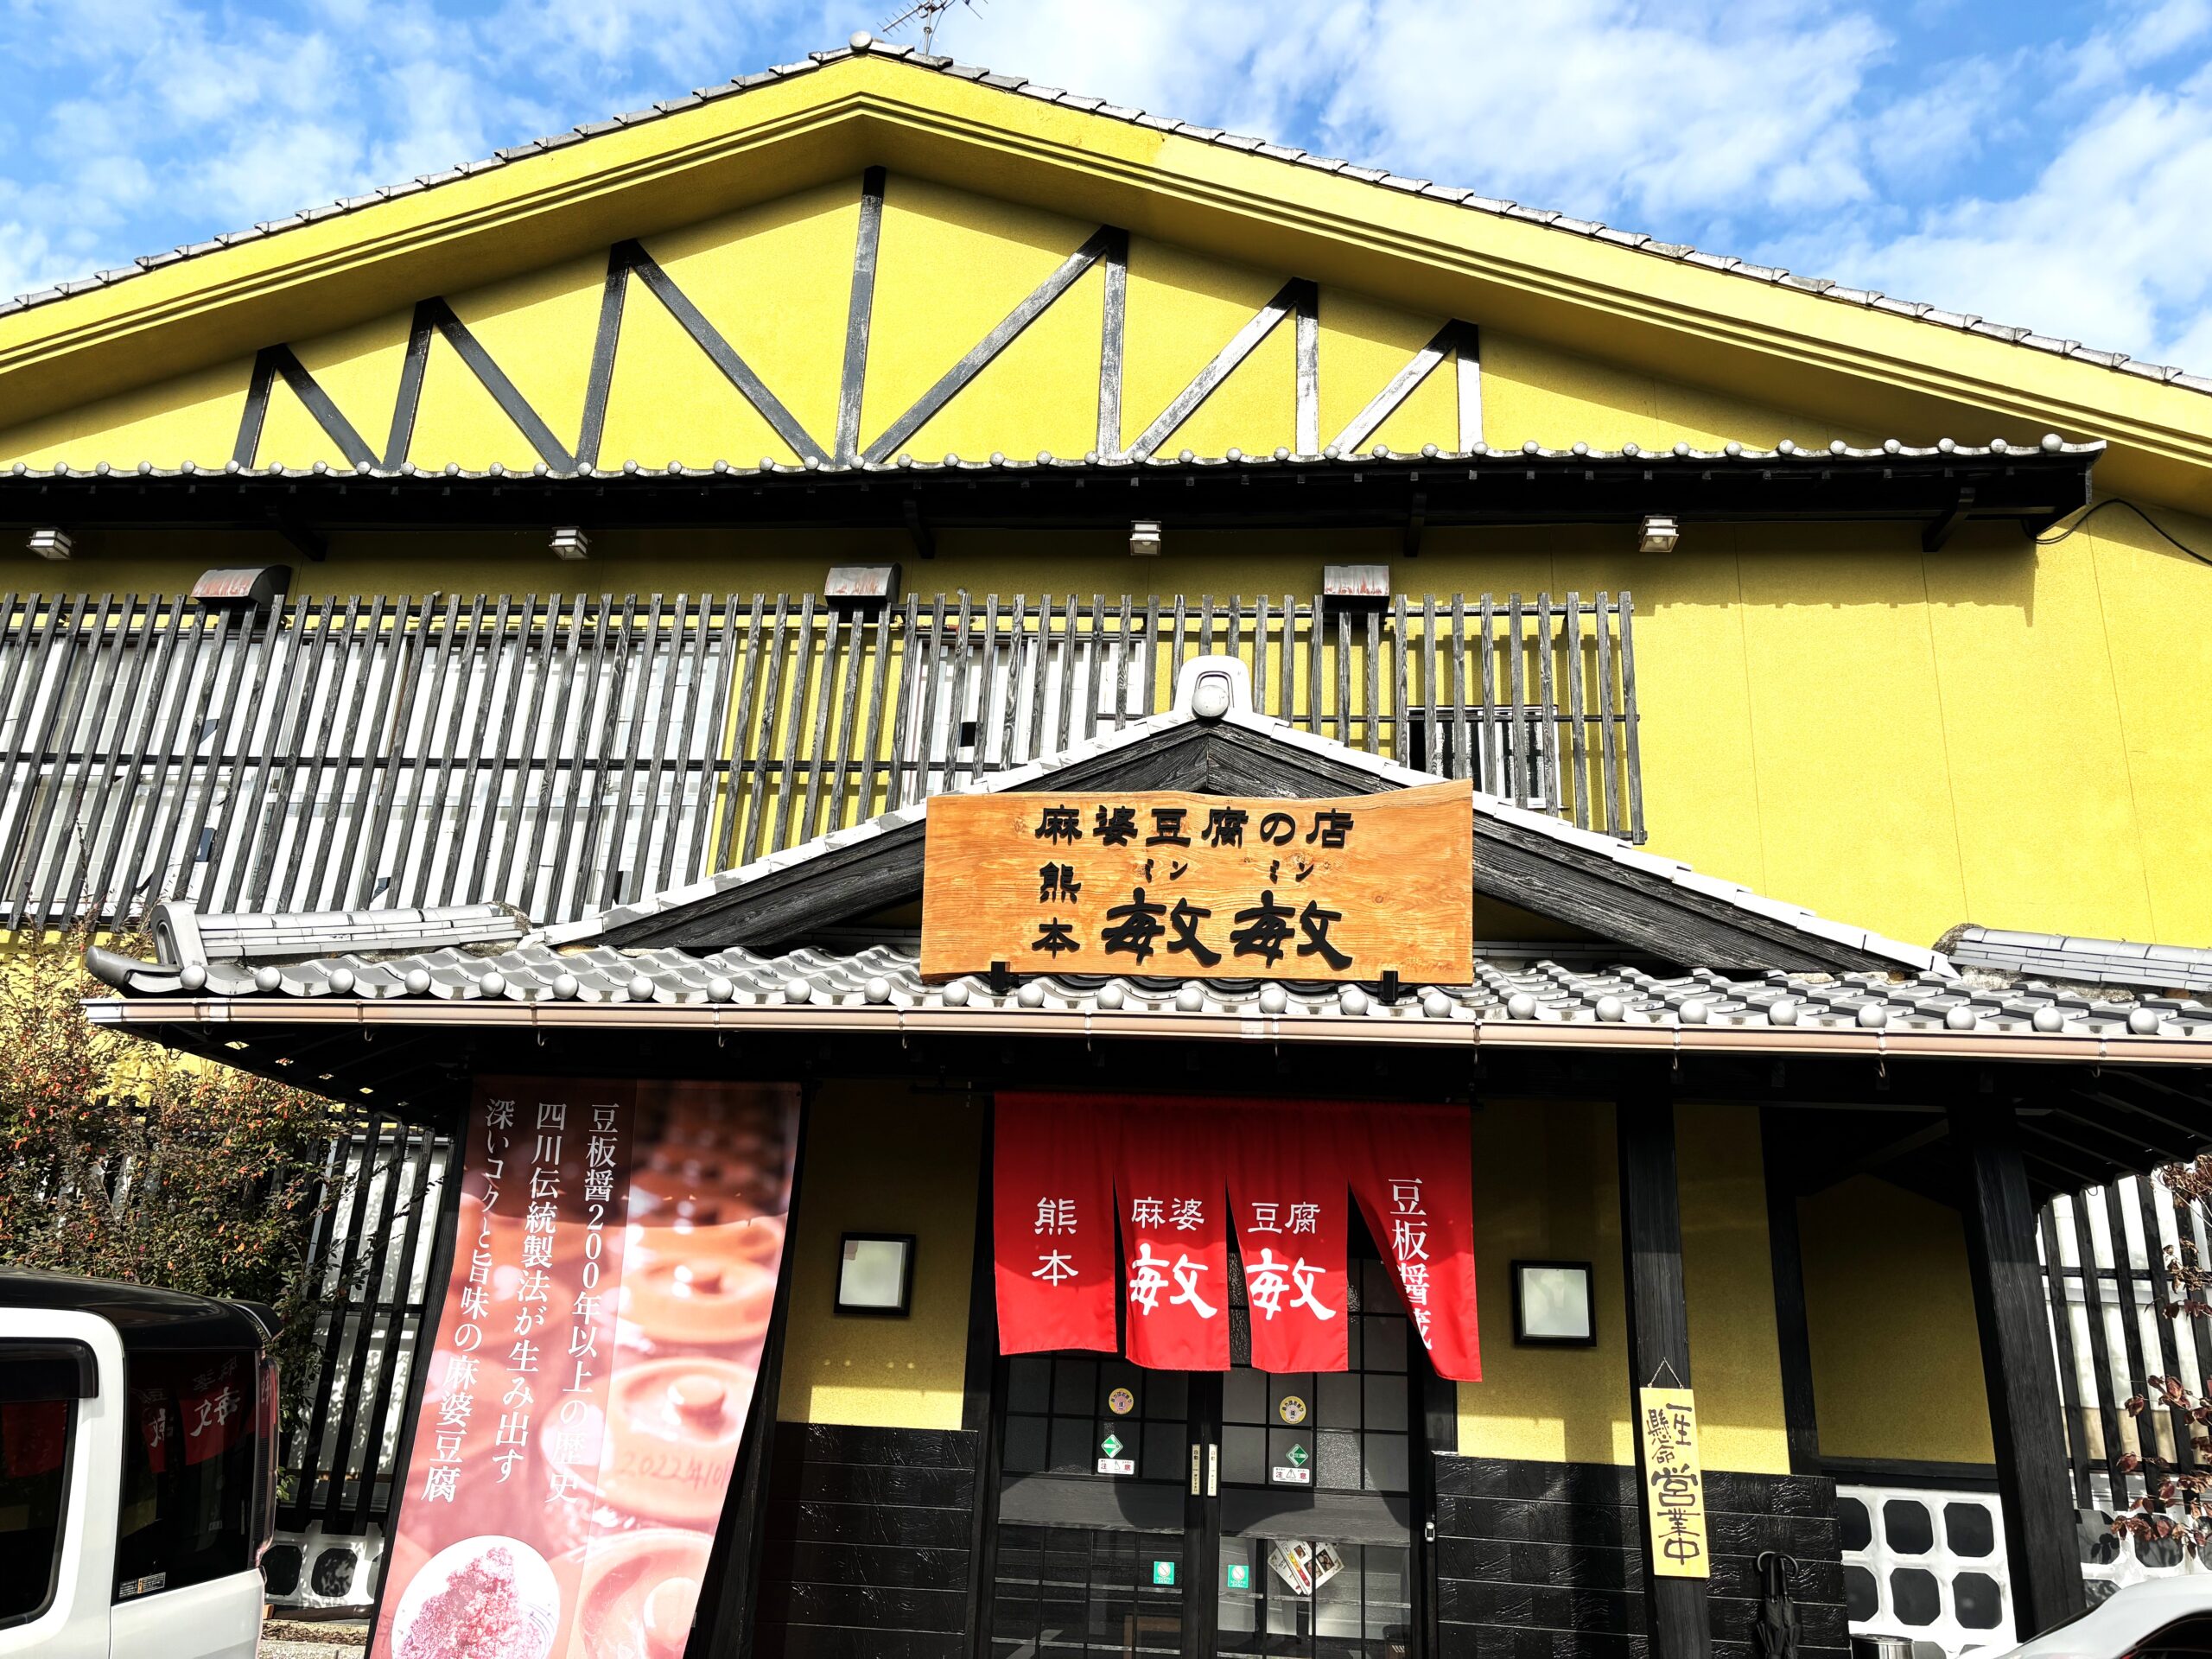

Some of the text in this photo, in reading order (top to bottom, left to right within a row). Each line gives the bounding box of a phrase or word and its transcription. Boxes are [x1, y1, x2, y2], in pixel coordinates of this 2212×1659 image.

[1034, 804, 1355, 849] 麻婆豆腐の店
[1269, 859, 1315, 883] ミン
[1032, 861, 1082, 959] 熊本
[1031, 1196, 1078, 1287] 熊本
[1130, 1196, 1205, 1231] 麻婆
[1247, 1201, 1321, 1235] 豆腐
[420, 1098, 516, 1503] 深いコクと旨味の麻婆豆腐
[491, 1102, 568, 1484] 四川伝統製法が生み出す
[1650, 1463, 1701, 1566] 営業中
